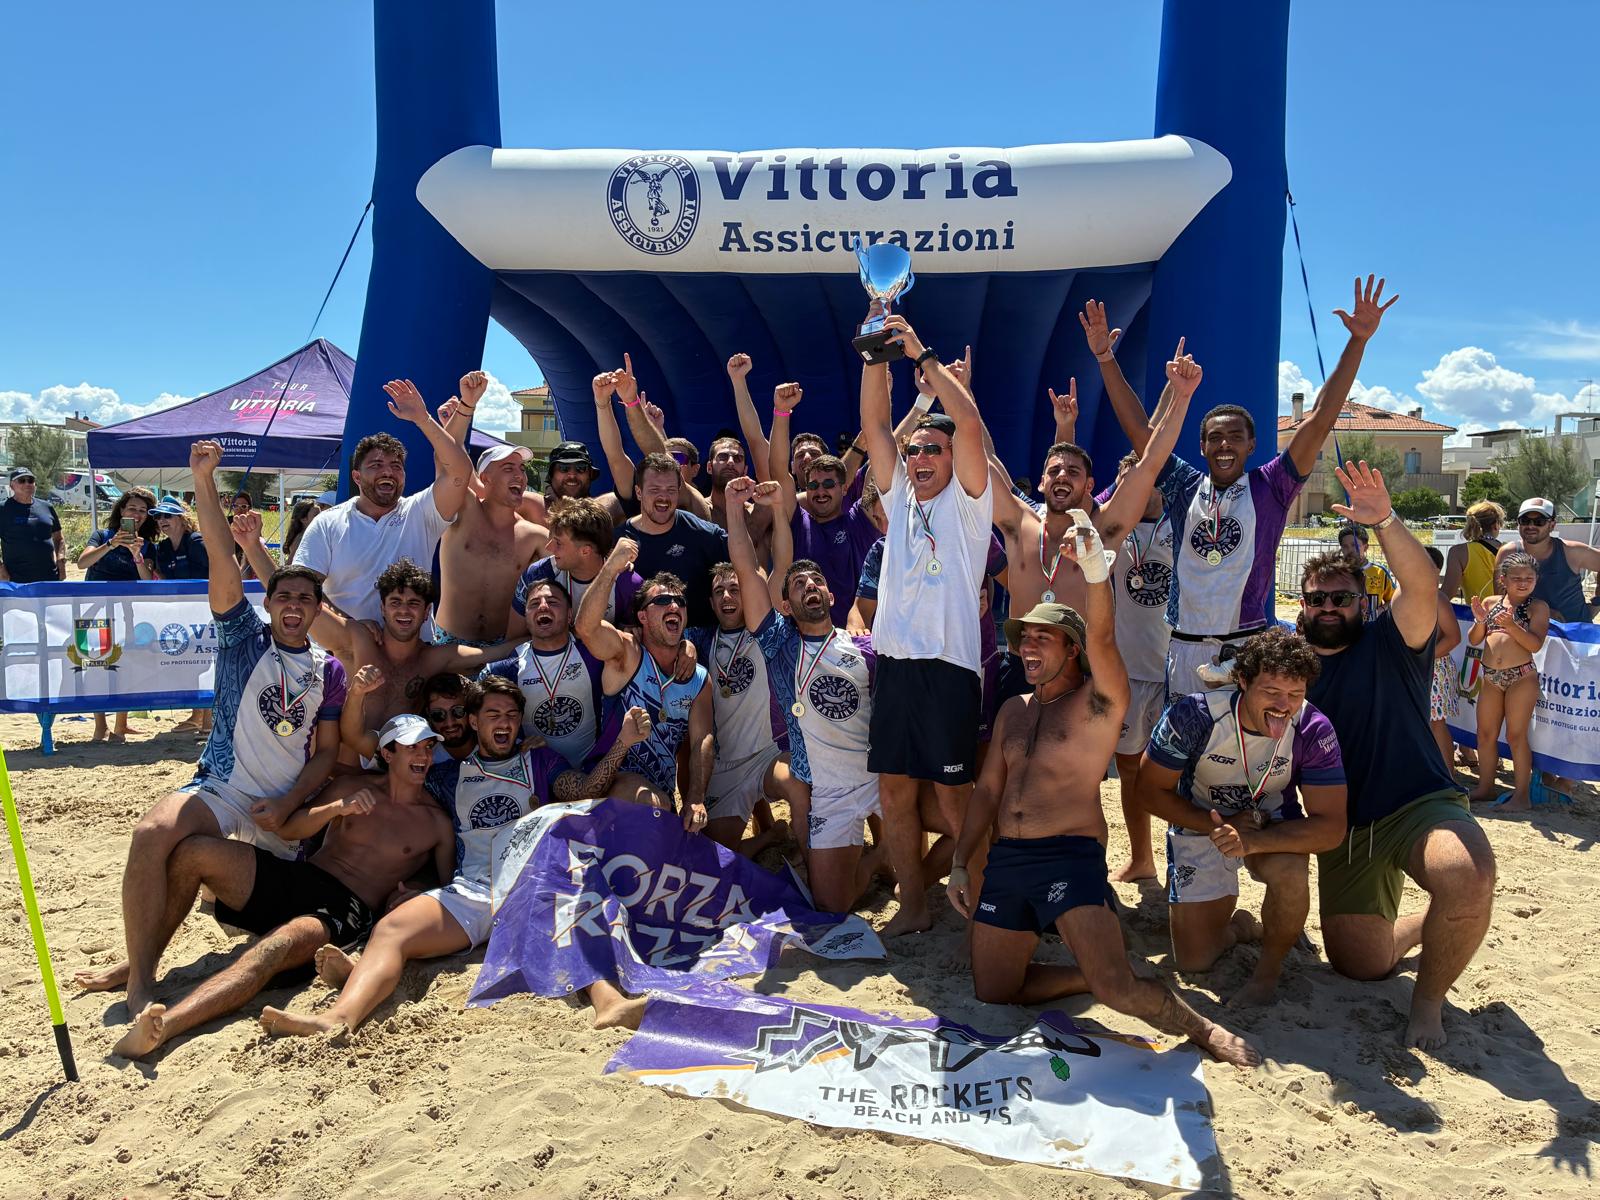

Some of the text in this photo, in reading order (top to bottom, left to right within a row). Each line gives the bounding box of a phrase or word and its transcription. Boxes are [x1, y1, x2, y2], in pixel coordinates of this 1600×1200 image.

[616, 155, 692, 179] VITTORIA
[707, 153, 1018, 201] Vittoria
[611, 198, 697, 252] ASSICURAZIONI
[272, 381, 309, 391] TOUR
[229, 398, 317, 412] VITTORIA
[220, 437, 257, 447] Vittoria
[810, 675, 858, 700] JUNGLE JUICE
[1537, 673, 1600, 700] ittori
[816, 704, 855, 719] BREWING
[1536, 699, 1600, 718] ssicurazio
[943, 763, 964, 773] RGR
[1207, 753, 1237, 765] RGR
[463, 775, 485, 783] RGR
[471, 796, 520, 822] JUNGLE JUICE
[566, 840, 760, 929] FORZA
[979, 902, 997, 913] RGR
[818, 1075, 1033, 1110] THE ROCKETS
[853, 1105, 1012, 1126] BEACH AND 7'S
